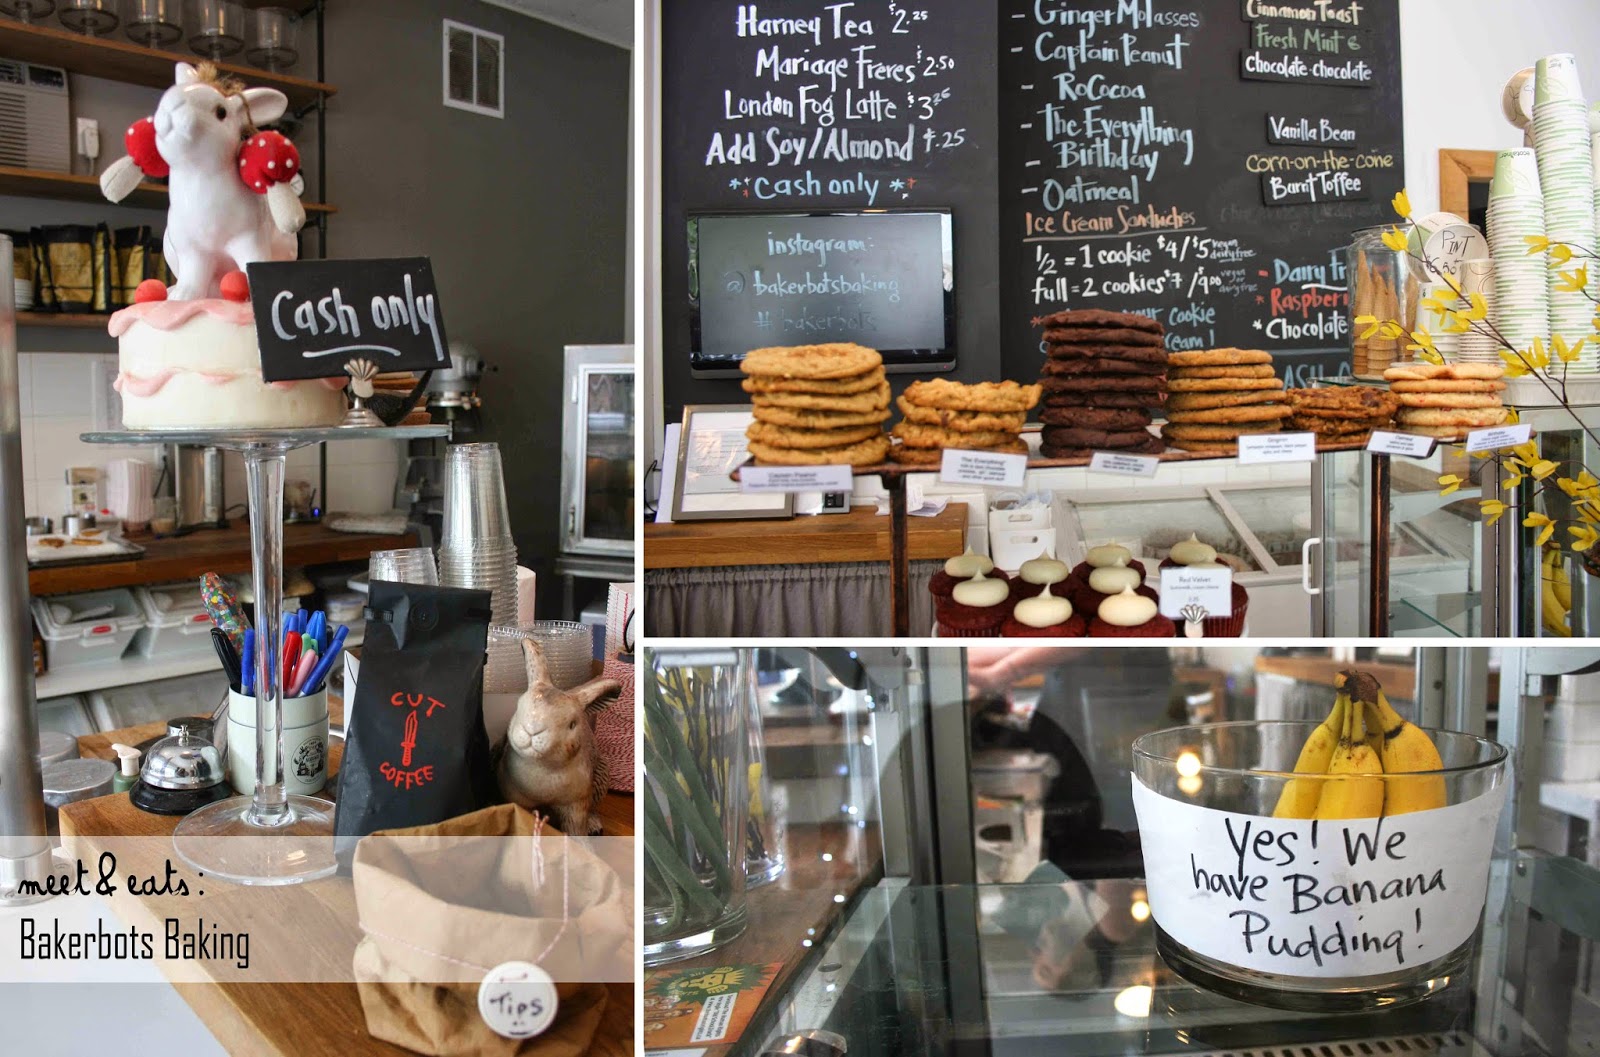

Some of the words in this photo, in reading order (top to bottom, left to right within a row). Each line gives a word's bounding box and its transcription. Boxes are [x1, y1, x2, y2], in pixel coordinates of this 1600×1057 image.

[736, 5, 821, 45] Harney
[825, 3, 873, 39] Tea
[1034, 0, 1115, 39] Ginger
[1116, 0, 1200, 29] Molasses
[1246, 0, 1316, 21] Cinnamon
[1313, 0, 1363, 25] Toast
[1035, 29, 1119, 71] Captain
[1119, 33, 1190, 69] Peanut
[1255, 24, 1297, 49] Fresh
[1303, 28, 1344, 54] Mint
[756, 46, 848, 92] Mariage
[725, 90, 793, 120] London
[799, 85, 835, 127] Fog
[846, 88, 897, 122] Latte
[705, 132, 756, 166] Add
[767, 123, 914, 166] Soy/Almond
[1036, 103, 1082, 142] The
[1083, 105, 1194, 166] Everything
[1270, 116, 1317, 141] Vanilla
[1319, 118, 1356, 142] Bean
[1052, 136, 1158, 181] Birthday
[828, 172, 879, 206] only
[1042, 174, 1139, 212] Oatmeal
[1269, 172, 1318, 202] Burnt
[1316, 171, 1362, 197] Toffee
[1025, 212, 1057, 236] Ice
[1062, 211, 1113, 234] Cream
[1116, 203, 1197, 234] Sandwiches
[1079, 244, 1094, 269] 1
[1097, 241, 1151, 267] cookie
[1441, 229, 1475, 258] PINT
[753, 270, 901, 303] bakerbotsbaking
[1031, 272, 1069, 305] full
[1081, 277, 1098, 298] 2
[1102, 271, 1167, 296] cookies
[1273, 257, 1326, 287] Dairy
[271, 287, 361, 341] Cash
[371, 273, 445, 362] only
[1265, 310, 1348, 340] Chocolate
[390, 691, 446, 718] CUT
[379, 761, 434, 790] COFFEE
[1225, 817, 1319, 879] Yes!
[1343, 816, 1407, 866] We
[1191, 853, 1268, 901] have
[1283, 868, 1446, 915] Banana
[1229, 907, 1424, 967] Pudding!
[489, 992, 543, 1016] Tips
